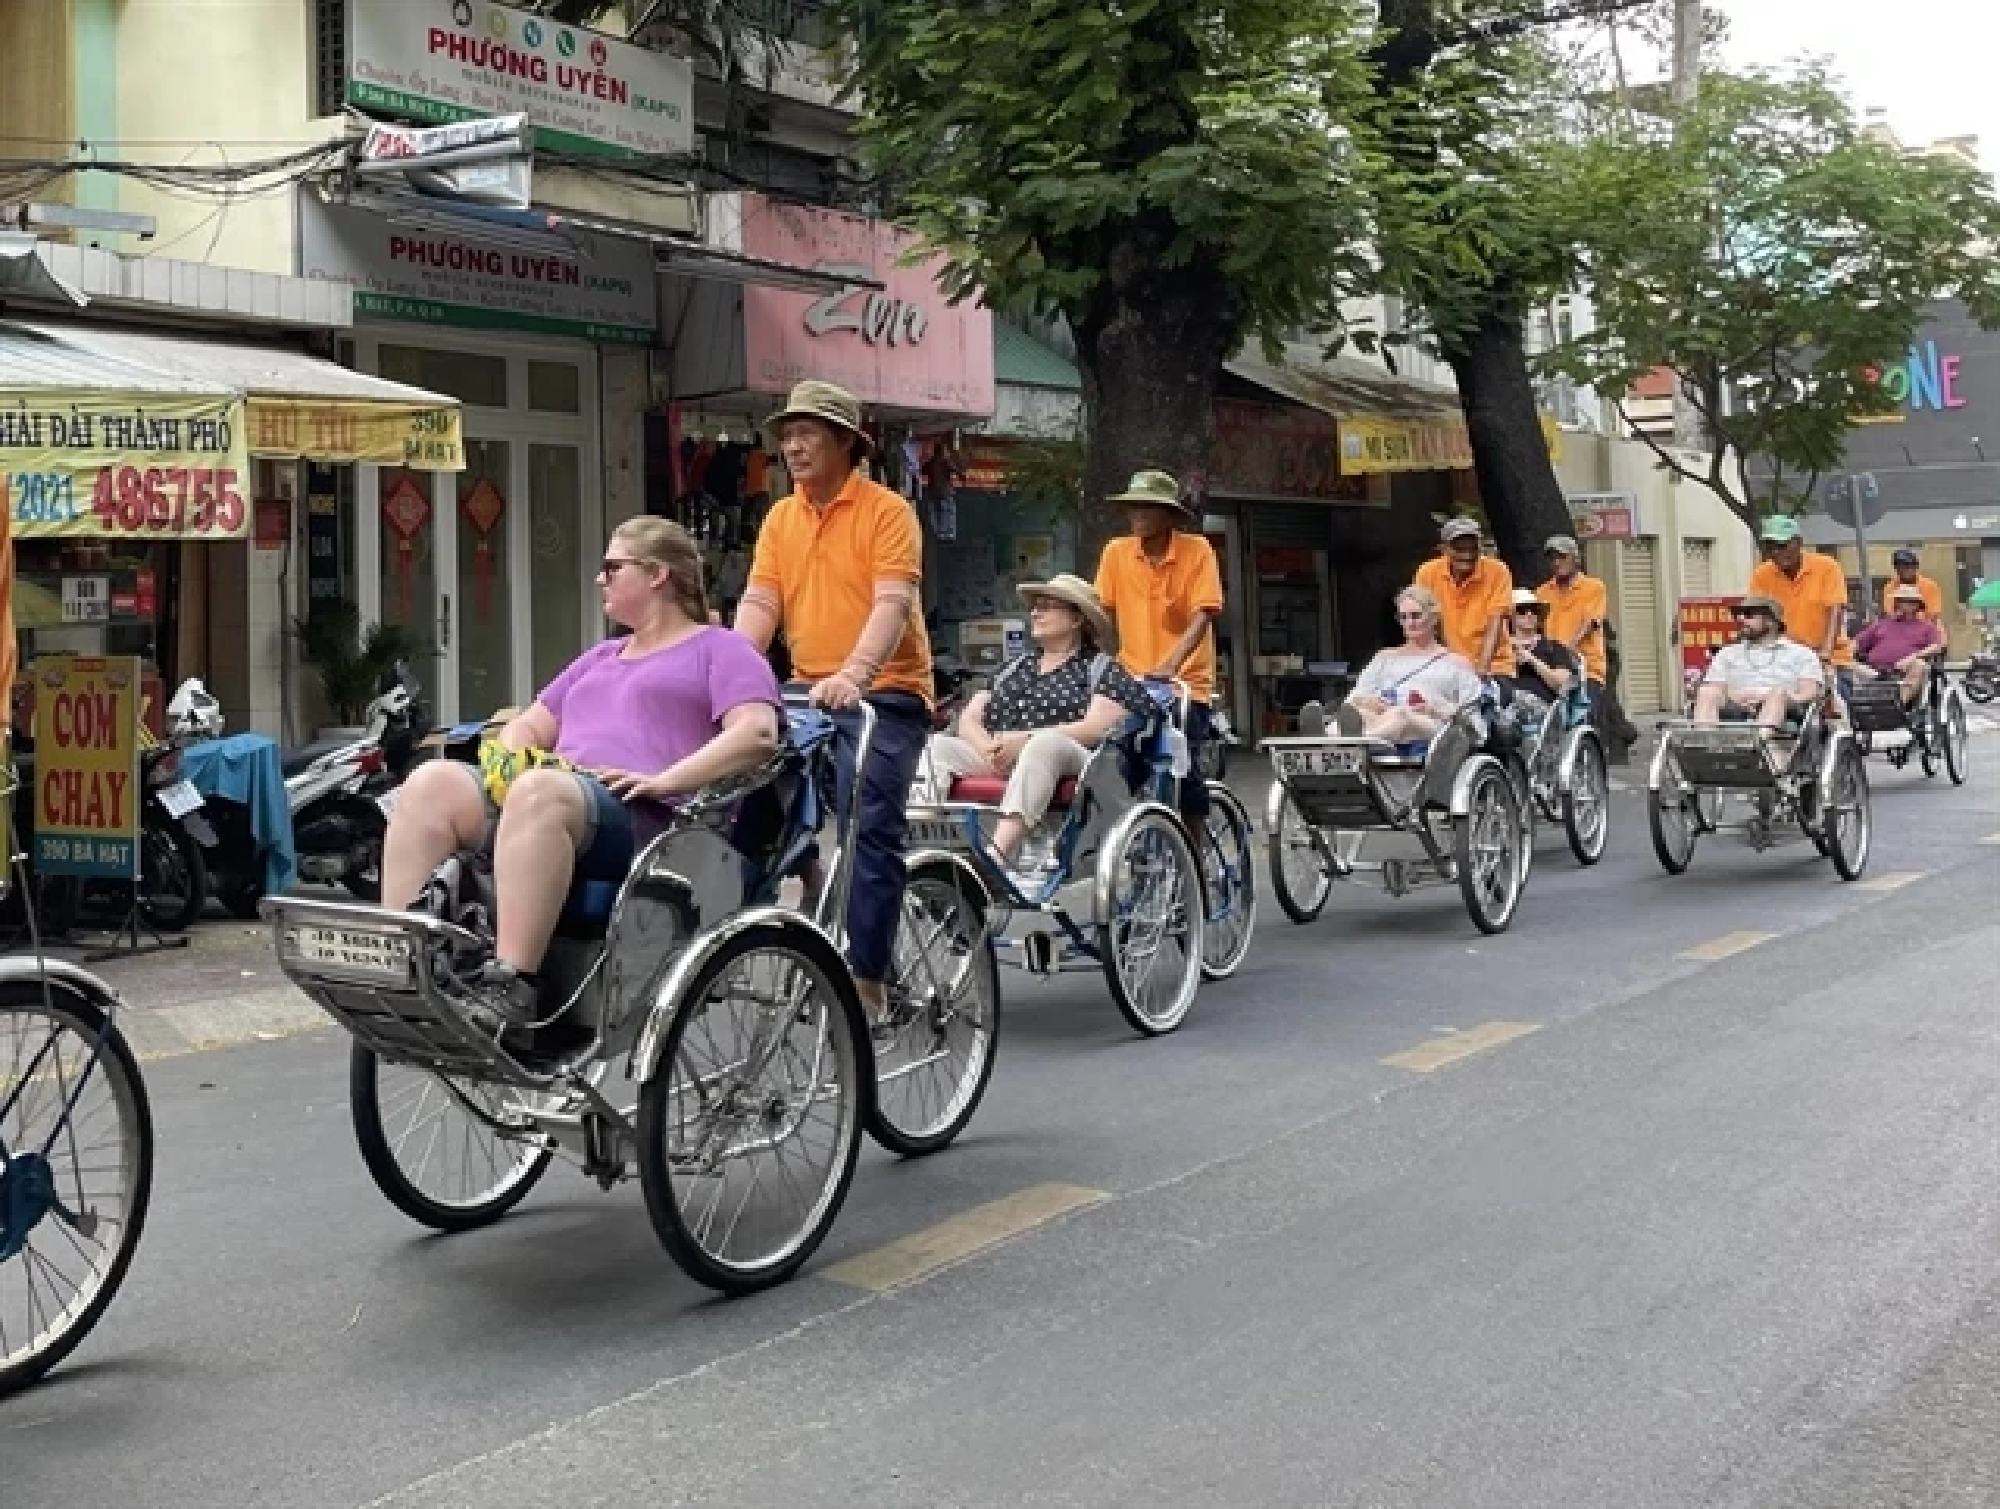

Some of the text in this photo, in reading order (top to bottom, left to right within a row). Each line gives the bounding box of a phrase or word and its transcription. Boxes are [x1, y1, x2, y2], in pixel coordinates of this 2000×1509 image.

[428, 27, 547, 83] PHƯƠNG
[556, 64, 628, 105] UYÊN
[390, 236, 503, 276] PHƯƠNG
[512, 256, 580, 286] UYÊN
[50, 404, 93, 448] ĐÀI
[99, 407, 181, 452] THÀNH
[93, 466, 244, 533] 486755
[53, 681, 117, 750] CƠM
[43, 768, 128, 829] CHAY
